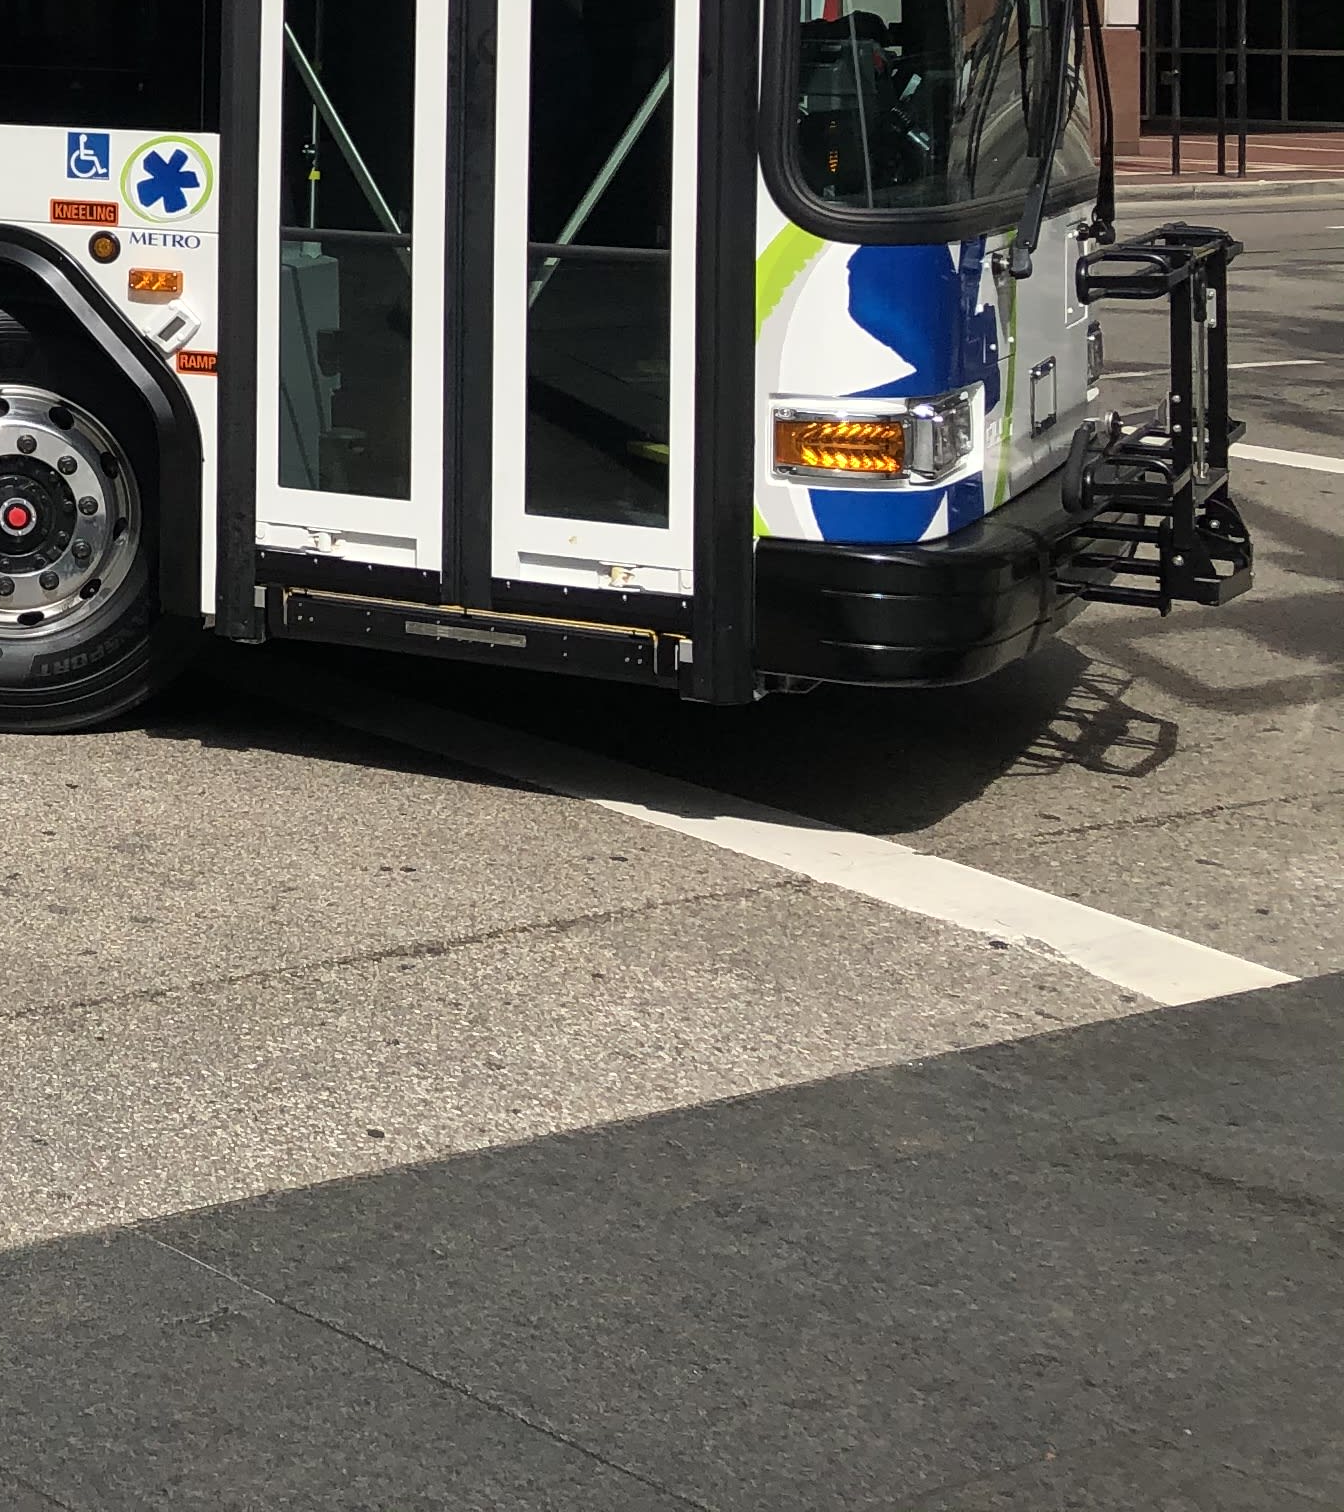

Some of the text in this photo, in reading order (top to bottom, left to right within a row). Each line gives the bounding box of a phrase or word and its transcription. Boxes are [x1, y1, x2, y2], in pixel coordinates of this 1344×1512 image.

[55, 203, 114, 221] KNEELING
[129, 231, 201, 249] METRO
[179, 354, 216, 370] RAMP
